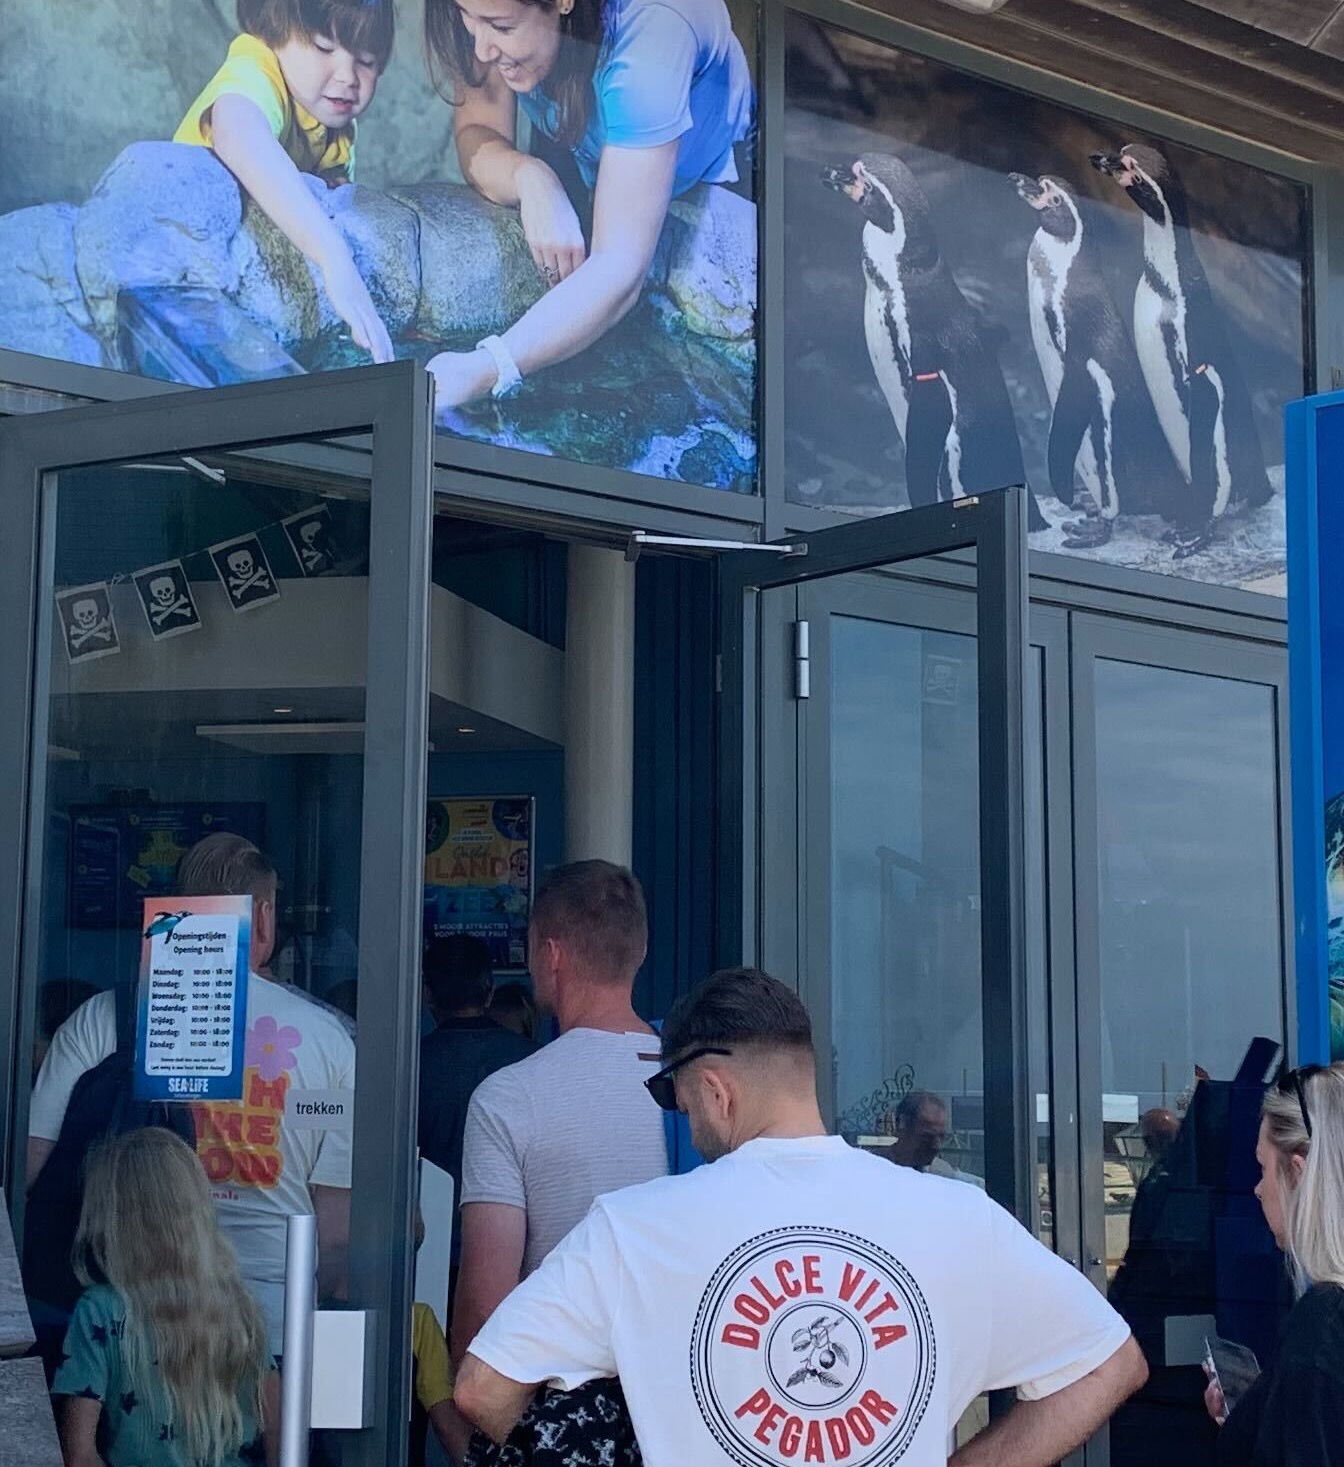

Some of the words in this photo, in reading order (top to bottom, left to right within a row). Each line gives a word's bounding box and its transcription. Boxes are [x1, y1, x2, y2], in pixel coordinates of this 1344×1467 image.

[434, 857, 508, 879] LAND
[172, 931, 226, 941] Openingstijden
[173, 945, 202, 955] Opening
[203, 945, 224, 953] hours
[151, 1004, 188, 1013] Donderdag:
[168, 1077, 188, 1093] SEA
[295, 1101, 344, 1115] trekken
[191, 1098, 276, 1145] THE
[197, 1147, 280, 1185] OW
[720, 1255, 824, 1351] DOLCE
[838, 1262, 908, 1351] VITA
[734, 1387, 898, 1464] PEGADOR
